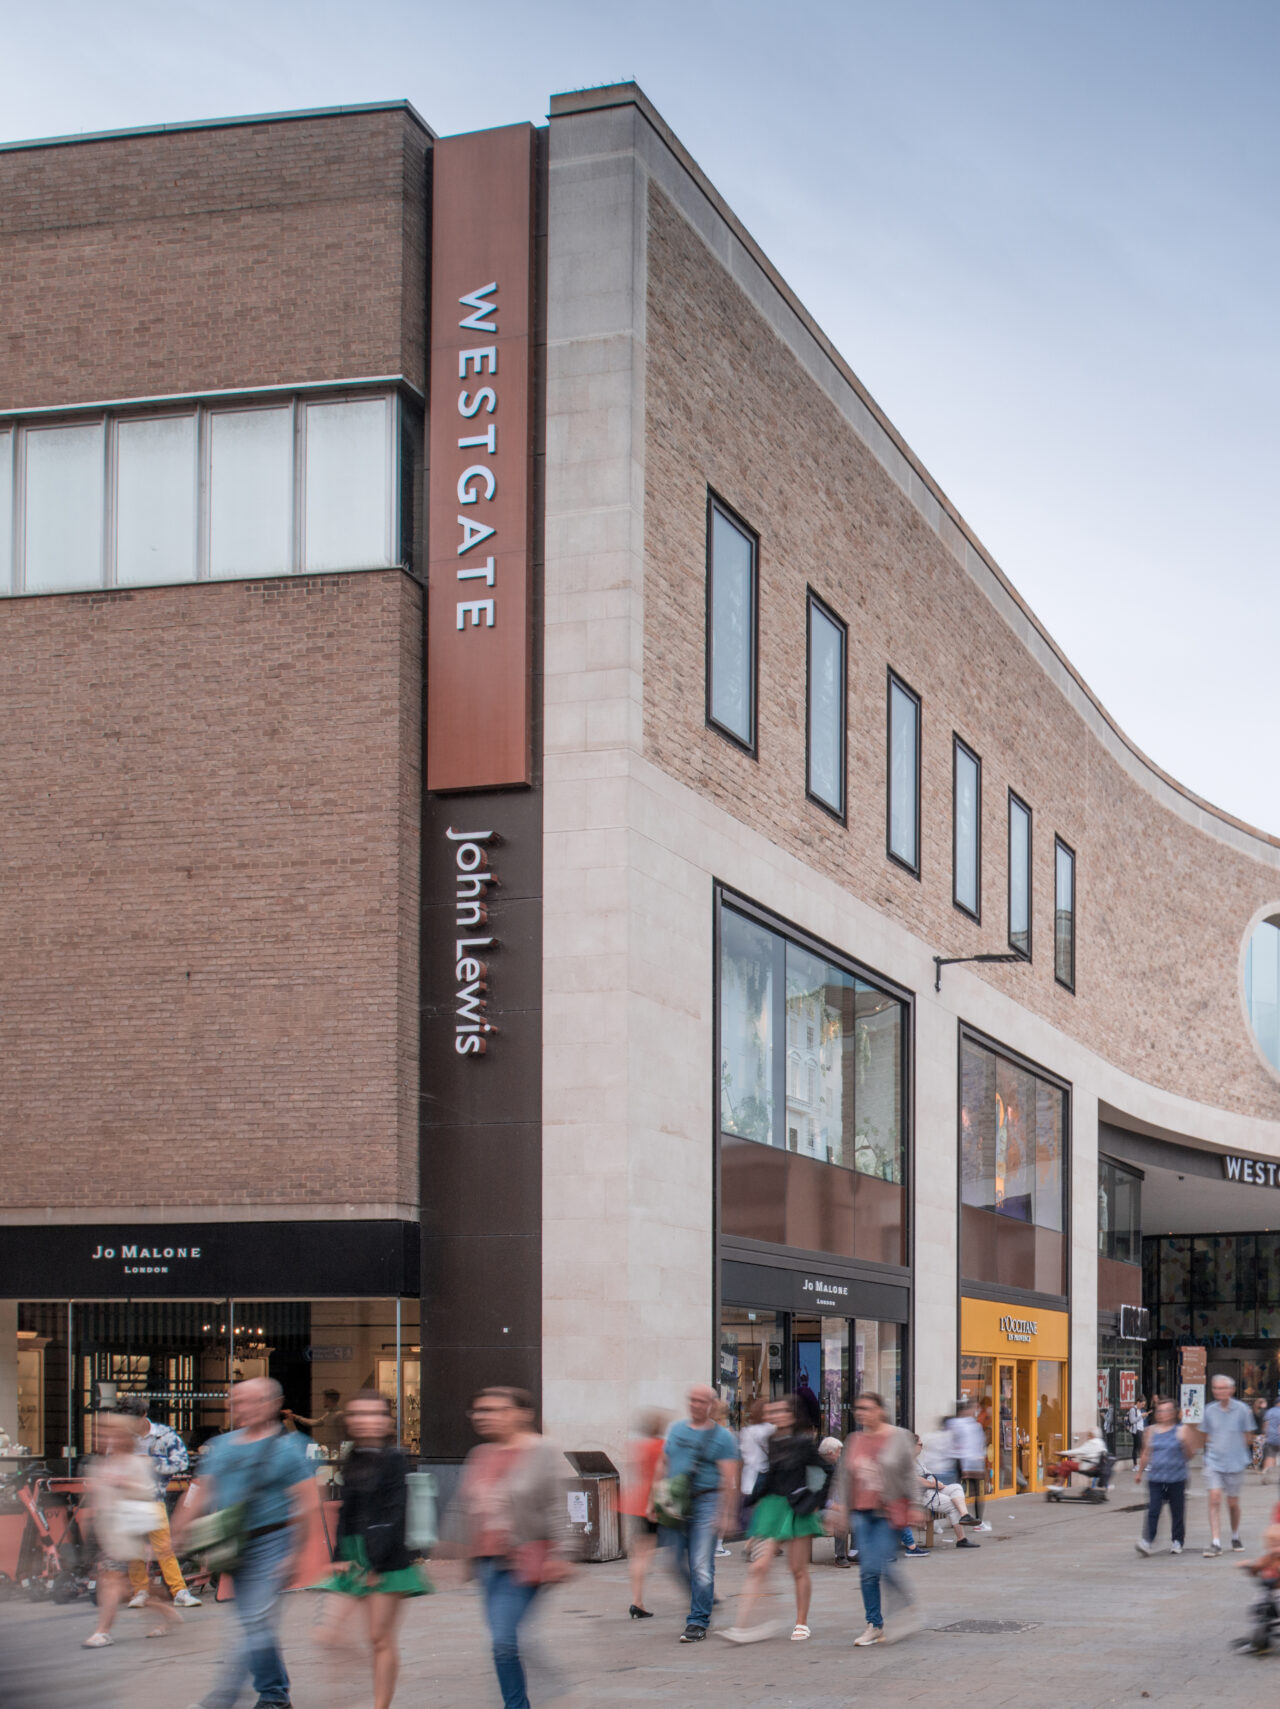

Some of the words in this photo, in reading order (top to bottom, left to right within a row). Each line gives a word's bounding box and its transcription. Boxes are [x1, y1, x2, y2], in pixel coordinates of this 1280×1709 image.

[457, 281, 497, 631] WESTGATE
[446, 826, 495, 926] John
[456, 937, 495, 1056] Lewis
[121, 1245, 201, 1259] MALONE
[124, 1265, 169, 1274] LONDON
[815, 1280, 848, 1295] MALONE
